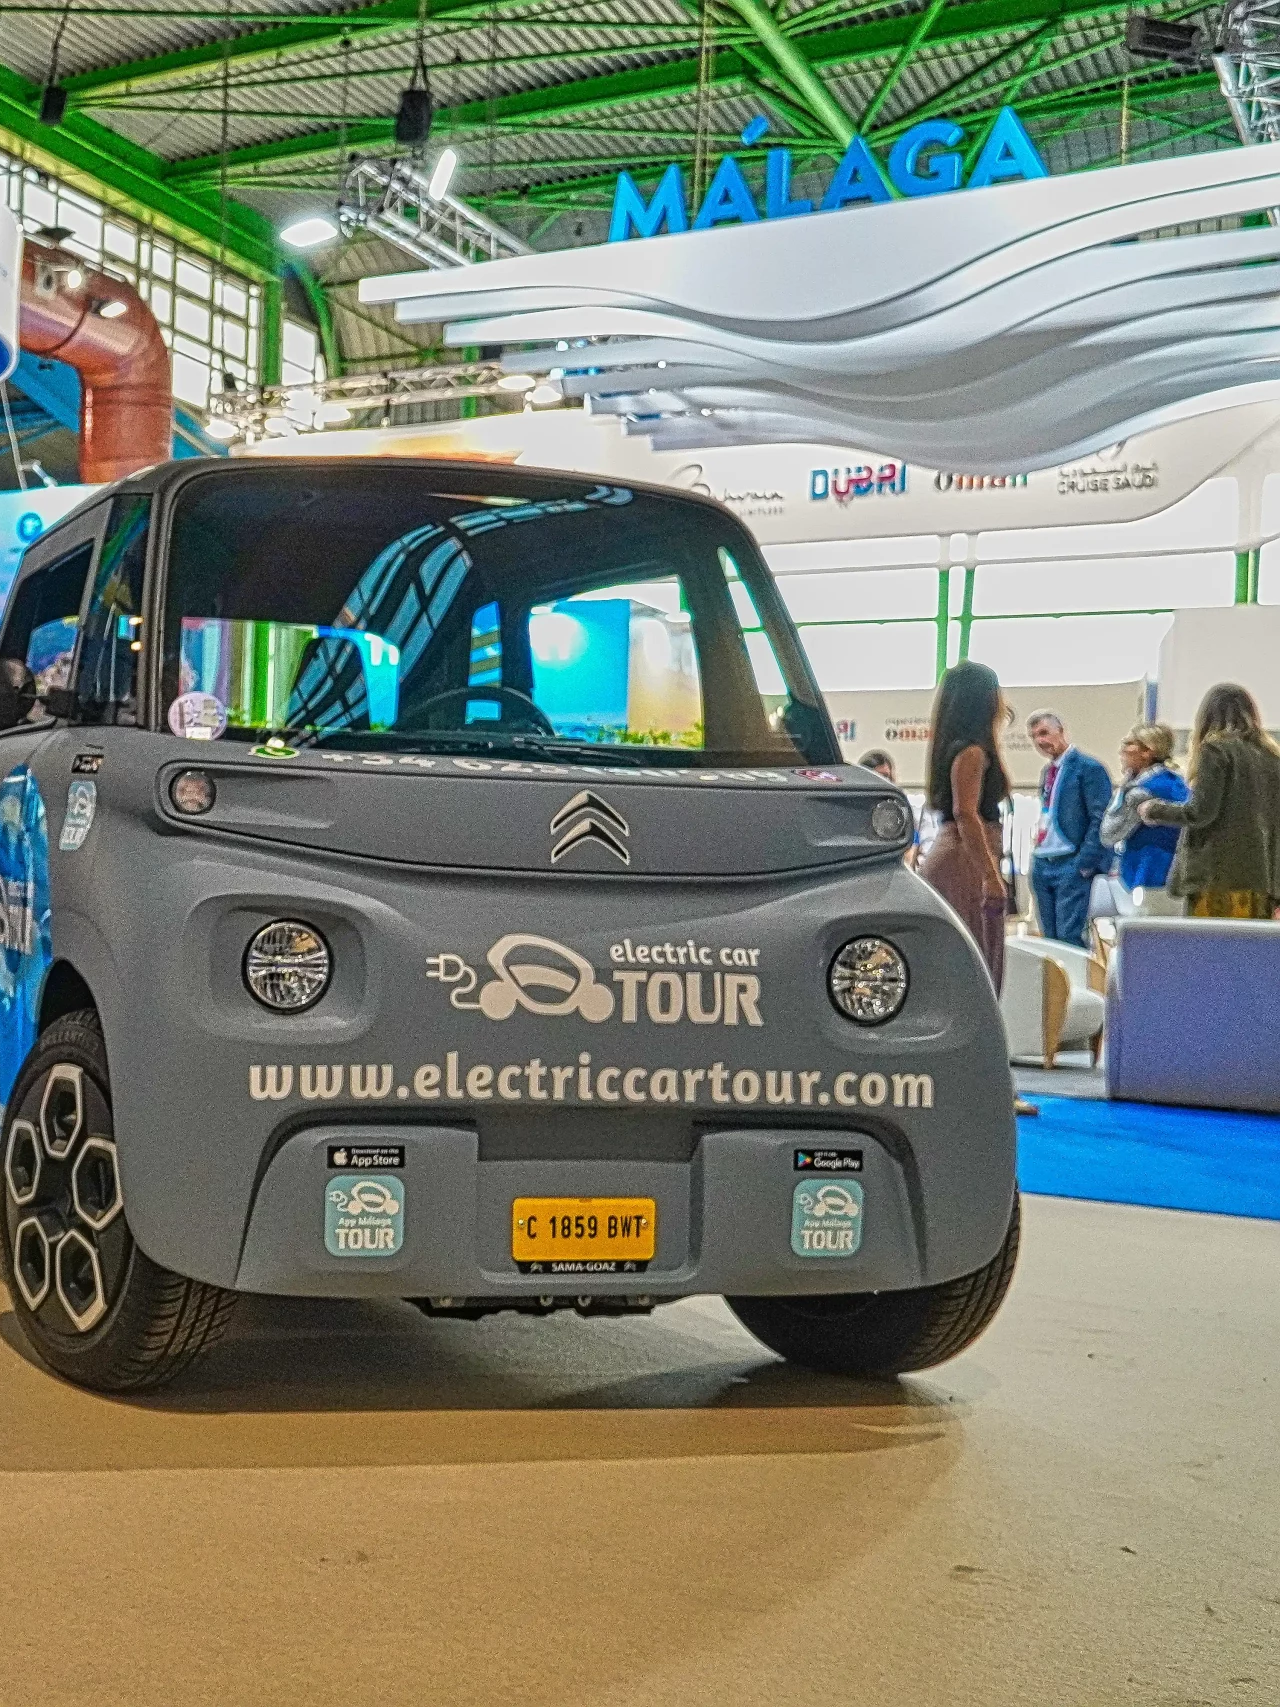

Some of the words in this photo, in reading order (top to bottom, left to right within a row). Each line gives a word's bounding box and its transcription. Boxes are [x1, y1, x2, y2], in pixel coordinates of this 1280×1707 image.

[607, 106, 1049, 242] MÁLAGA
[1057, 474, 1109, 494] CRUISE
[610, 938, 713, 968] electric
[719, 946, 760, 969] car
[612, 970, 764, 1027] TOUR
[249, 1050, 935, 1109] www.electriccartour.com
[351, 1154, 372, 1167] App
[373, 1154, 400, 1166] Store
[814, 1157, 842, 1169] Google
[843, 1157, 860, 1169] Play
[527, 1215, 537, 1239] C
[549, 1215, 598, 1239] 1859
[608, 1215, 644, 1239] BWT
[335, 1228, 396, 1250] TOUR
[801, 1229, 853, 1250] TOUR
[551, 1262, 617, 1273] SAMA-GOAZ
